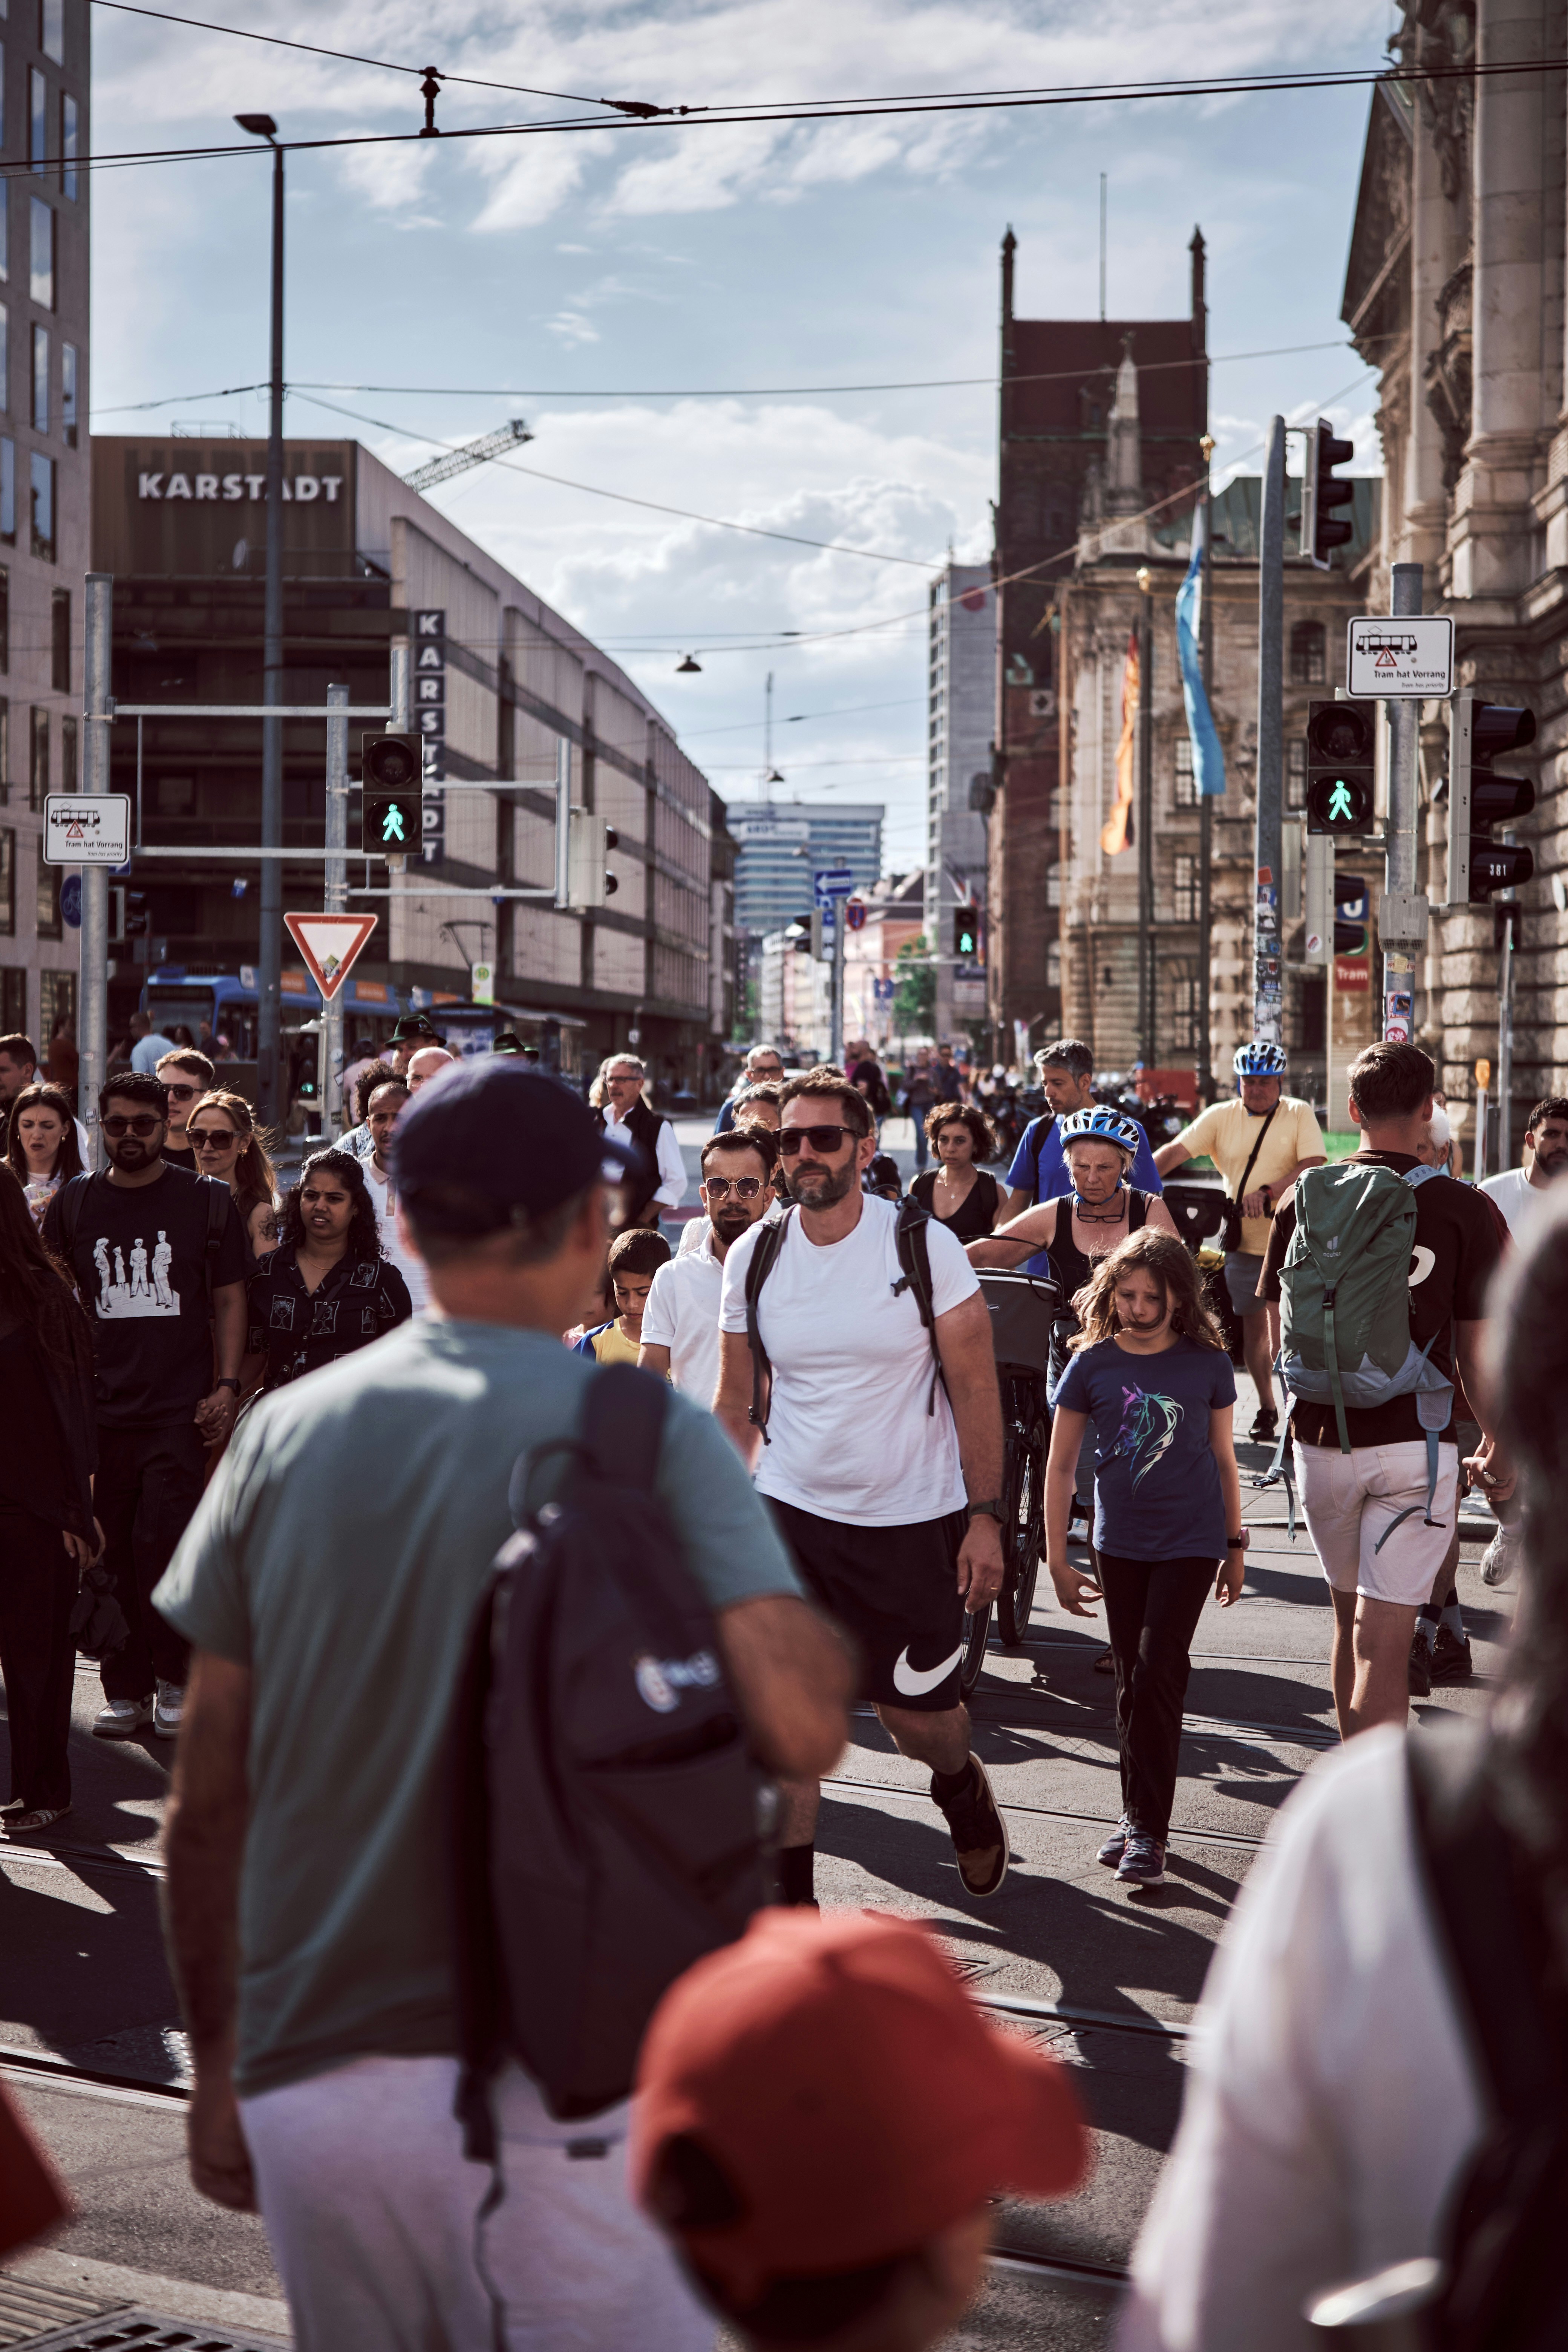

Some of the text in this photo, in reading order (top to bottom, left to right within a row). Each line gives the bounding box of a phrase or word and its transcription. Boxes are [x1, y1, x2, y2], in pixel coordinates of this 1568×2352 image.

[1413, 670, 1445, 680] Vorrang
[96, 841, 122, 849] Vorrang
[1490, 864, 1506, 876] 381
[1337, 965, 1368, 980] Tram
